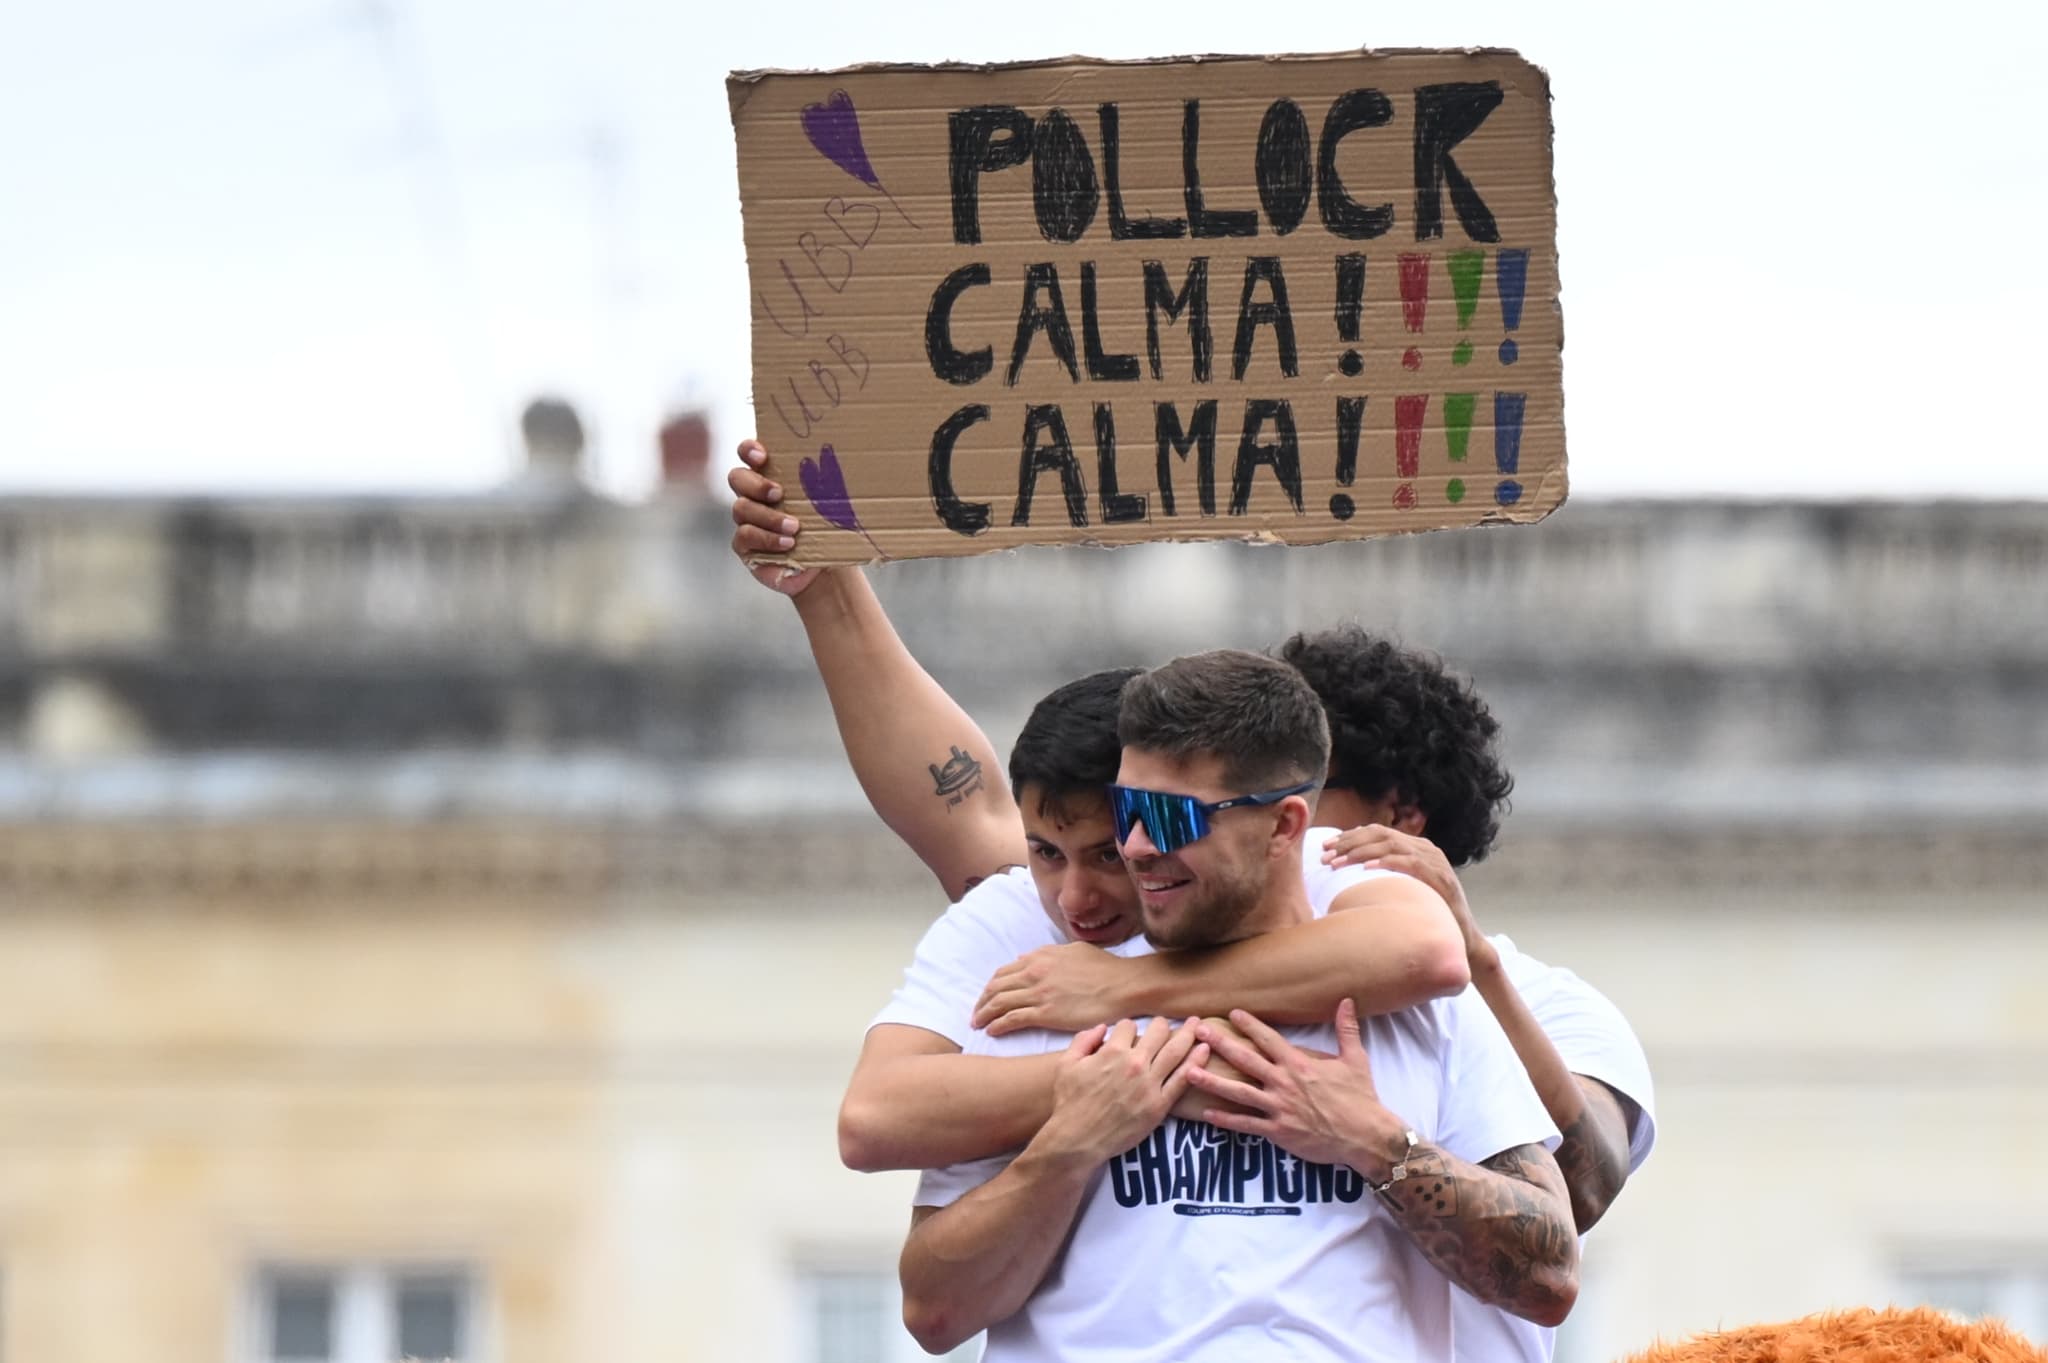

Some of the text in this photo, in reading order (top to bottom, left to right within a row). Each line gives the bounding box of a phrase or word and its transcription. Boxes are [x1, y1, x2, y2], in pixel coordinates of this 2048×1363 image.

[947, 80, 1505, 244] POLLOCK
[759, 195, 881, 338] UBB
[771, 333, 871, 439] UBB
